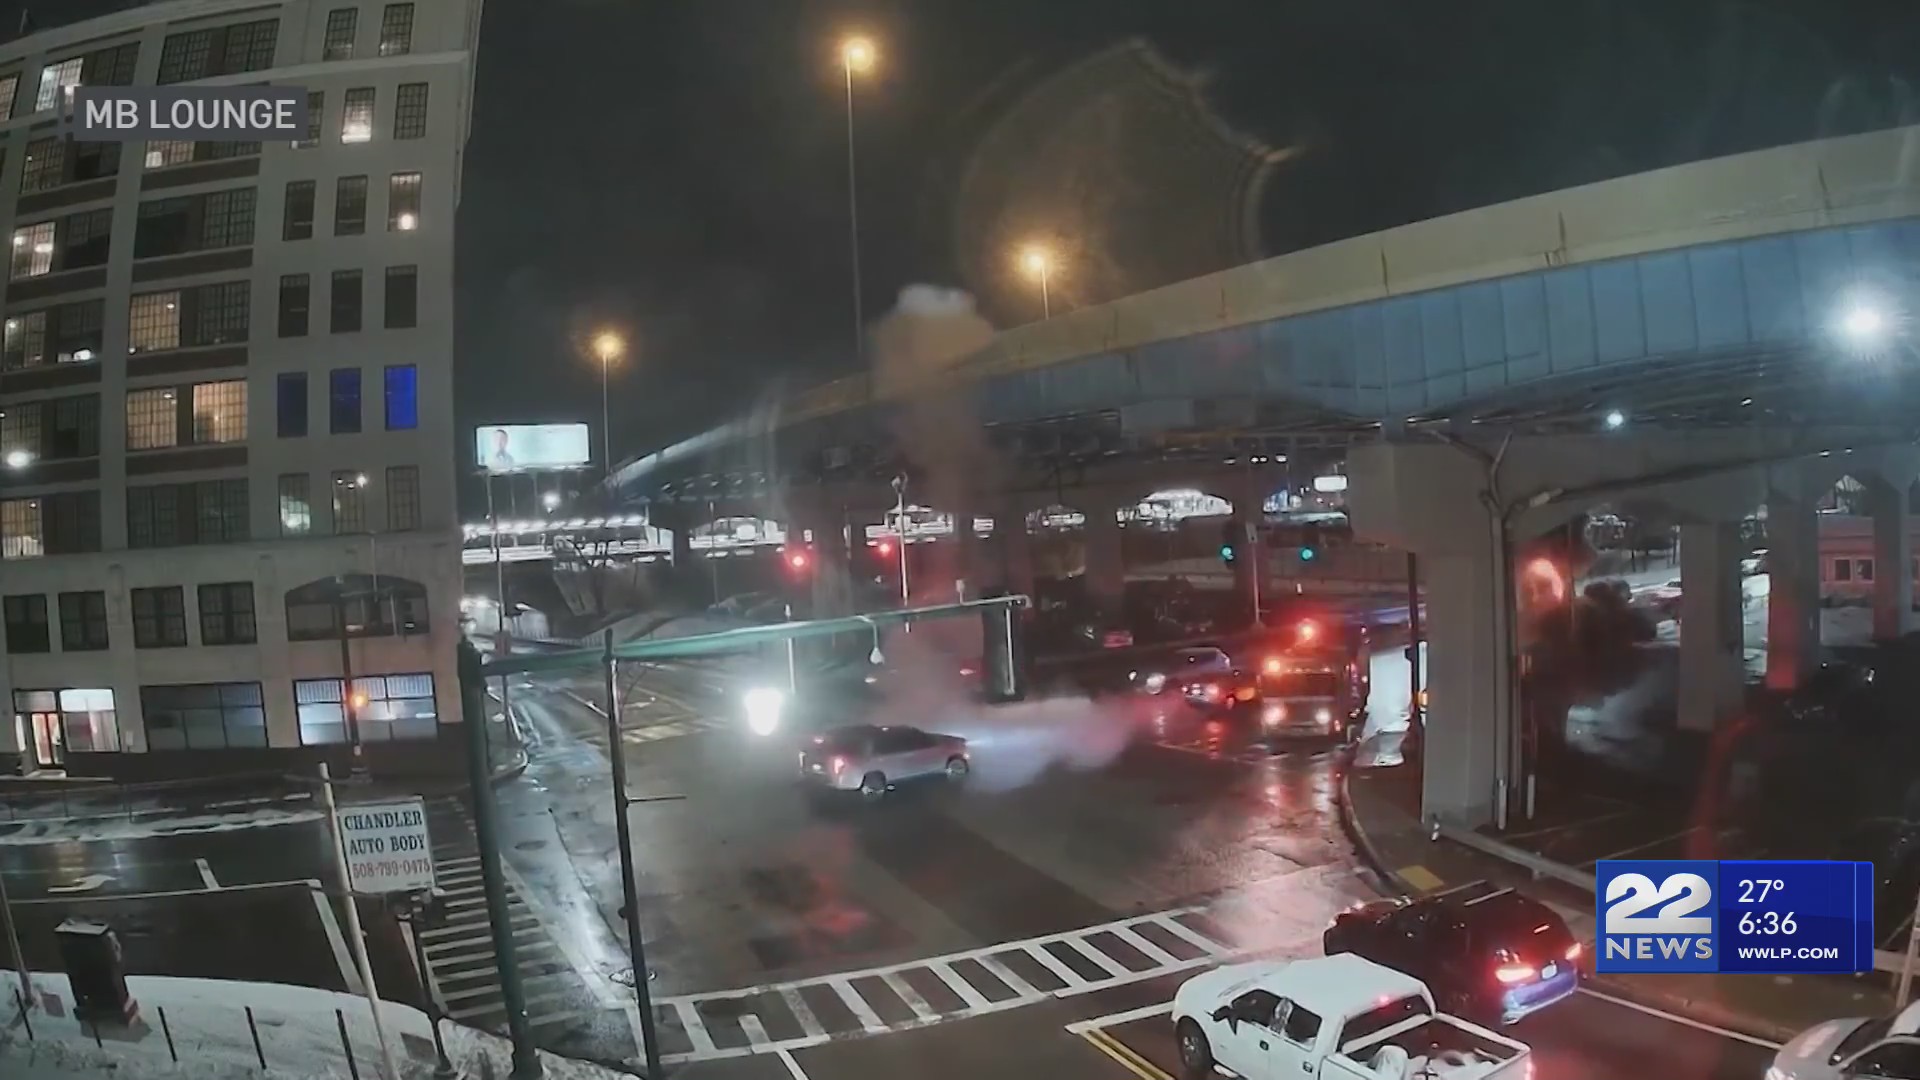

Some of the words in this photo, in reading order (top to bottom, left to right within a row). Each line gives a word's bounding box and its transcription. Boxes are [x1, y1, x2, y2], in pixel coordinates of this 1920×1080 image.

[344, 810, 422, 830] CHANDLER
[350, 837, 385, 855] AUTO
[390, 834, 425, 852] BODY
